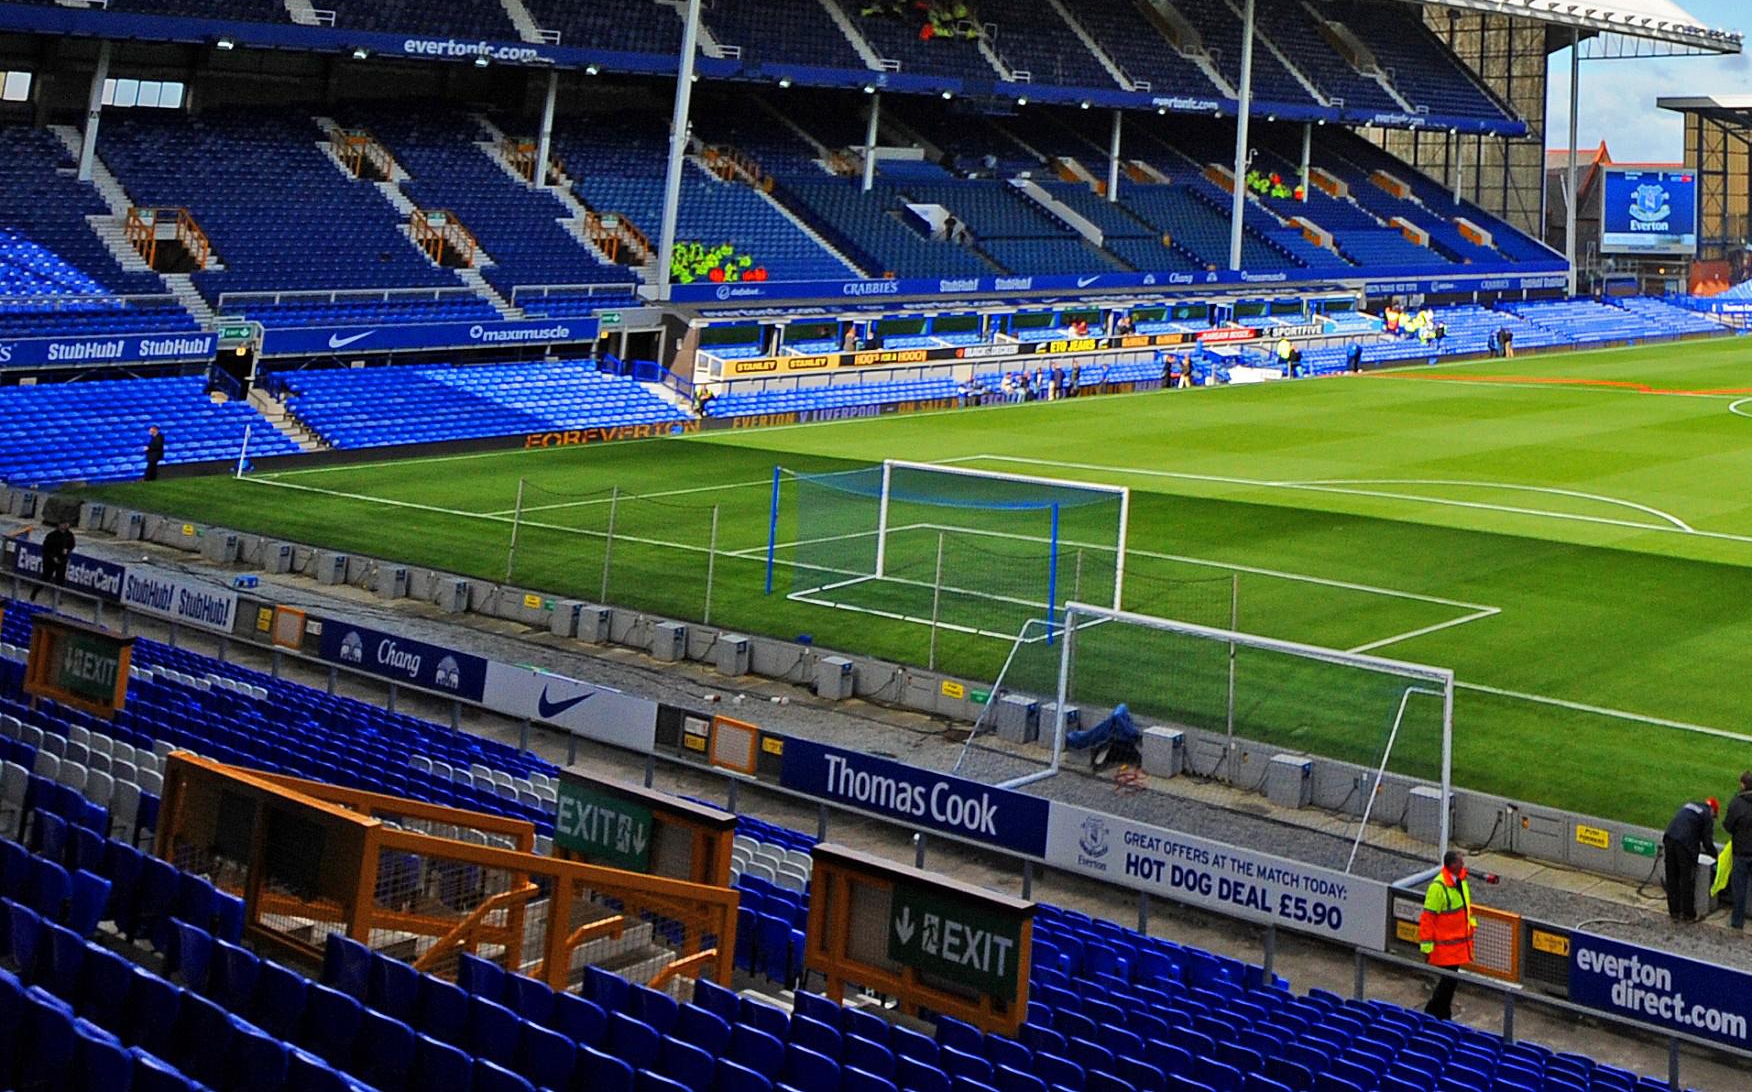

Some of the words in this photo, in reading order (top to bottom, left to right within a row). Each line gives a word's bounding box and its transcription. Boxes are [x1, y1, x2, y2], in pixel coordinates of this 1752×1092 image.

[404, 39, 537, 62] evertonfc.com
[1630, 219, 1669, 231] Everton
[843, 282, 899, 296] CRABBIE'S
[139, 337, 212, 357] StubHub!
[482, 325, 570, 342] maximuscle
[1272, 324, 1323, 338] SPORTFIVE
[48, 340, 125, 360] StubHub!
[732, 412, 795, 429] EVERTON
[812, 405, 881, 422] LIVERPOOL
[66, 559, 122, 595] asterCard
[125, 574, 175, 611] StubHub!
[178, 588, 231, 626] StubHub!
[83, 649, 120, 687] EXIT
[377, 638, 421, 678] Chang
[824, 753, 926, 817] Thomas
[930, 781, 999, 836] Cook
[556, 794, 616, 847] EXIT
[1077, 854, 1107, 872] Everton
[1124, 830, 1162, 851] GREAT
[1163, 840, 1209, 865] OFFERS
[1211, 853, 1229, 869] AT
[1230, 857, 1254, 876] THE
[1256, 864, 1300, 889] MATCH
[1302, 876, 1348, 901] TODAY:
[1125, 853, 1166, 883] HOT
[1170, 865, 1213, 896] DOG
[1217, 877, 1273, 914] DEAL
[1278, 893, 1343, 931] £5.90
[942, 918, 1014, 977] EXIT
[1576, 947, 1672, 992] everton
[1611, 979, 1748, 1040] direct.com
